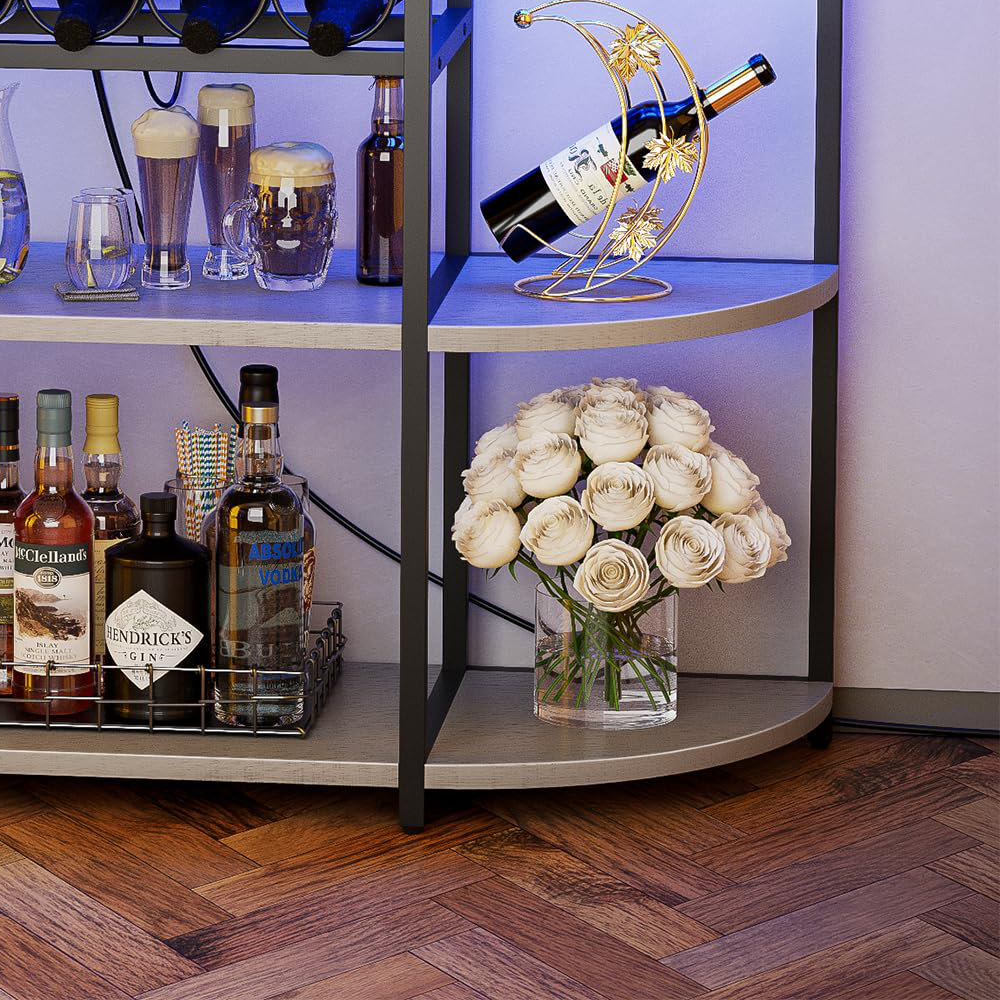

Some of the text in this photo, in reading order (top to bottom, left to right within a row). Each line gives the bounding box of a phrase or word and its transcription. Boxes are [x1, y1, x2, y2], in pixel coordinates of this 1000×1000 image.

[15, 545, 87, 564] McClelland's
[38, 574, 58, 583] 1818
[106, 624, 192, 646] HENDRICK'S
[130, 651, 157, 661] GIN
